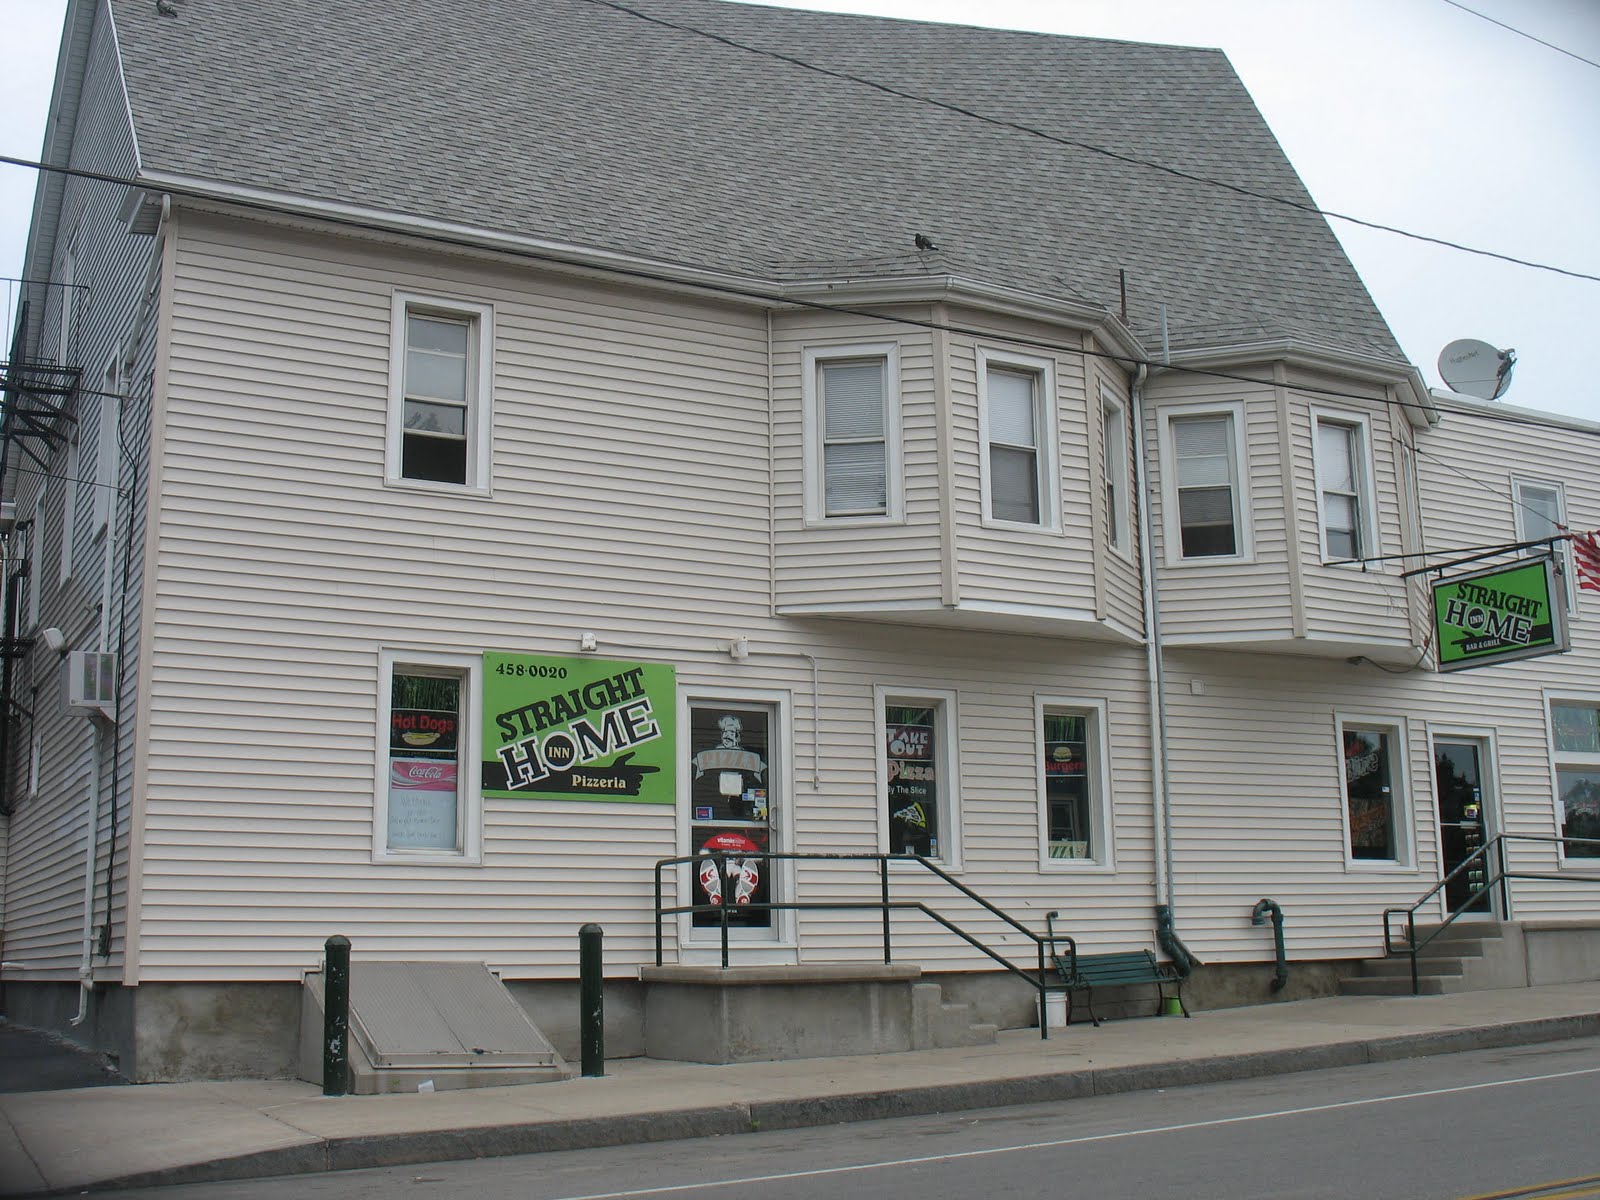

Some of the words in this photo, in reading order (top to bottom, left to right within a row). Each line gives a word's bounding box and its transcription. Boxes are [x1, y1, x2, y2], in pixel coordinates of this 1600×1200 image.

[1457, 581, 1542, 618] STRAIGHT
[1443, 598, 1533, 645] HOME
[1469, 614, 1484, 625] INN
[1466, 643, 1478, 651] BAR
[1483, 638, 1501, 648] GRILL
[496, 667, 645, 743] STRAIGHT
[392, 713, 416, 729] Hot
[419, 715, 455, 734] Dogs
[496, 697, 662, 791] HOME
[886, 728, 928, 744] TAKE
[548, 746, 571, 759] INN
[890, 740, 924, 755] OUT
[887, 760, 935, 782] Pizza
[572, 774, 627, 789] Pizzeria
[896, 785, 909, 794] The
[910, 786, 927, 795] Slice
